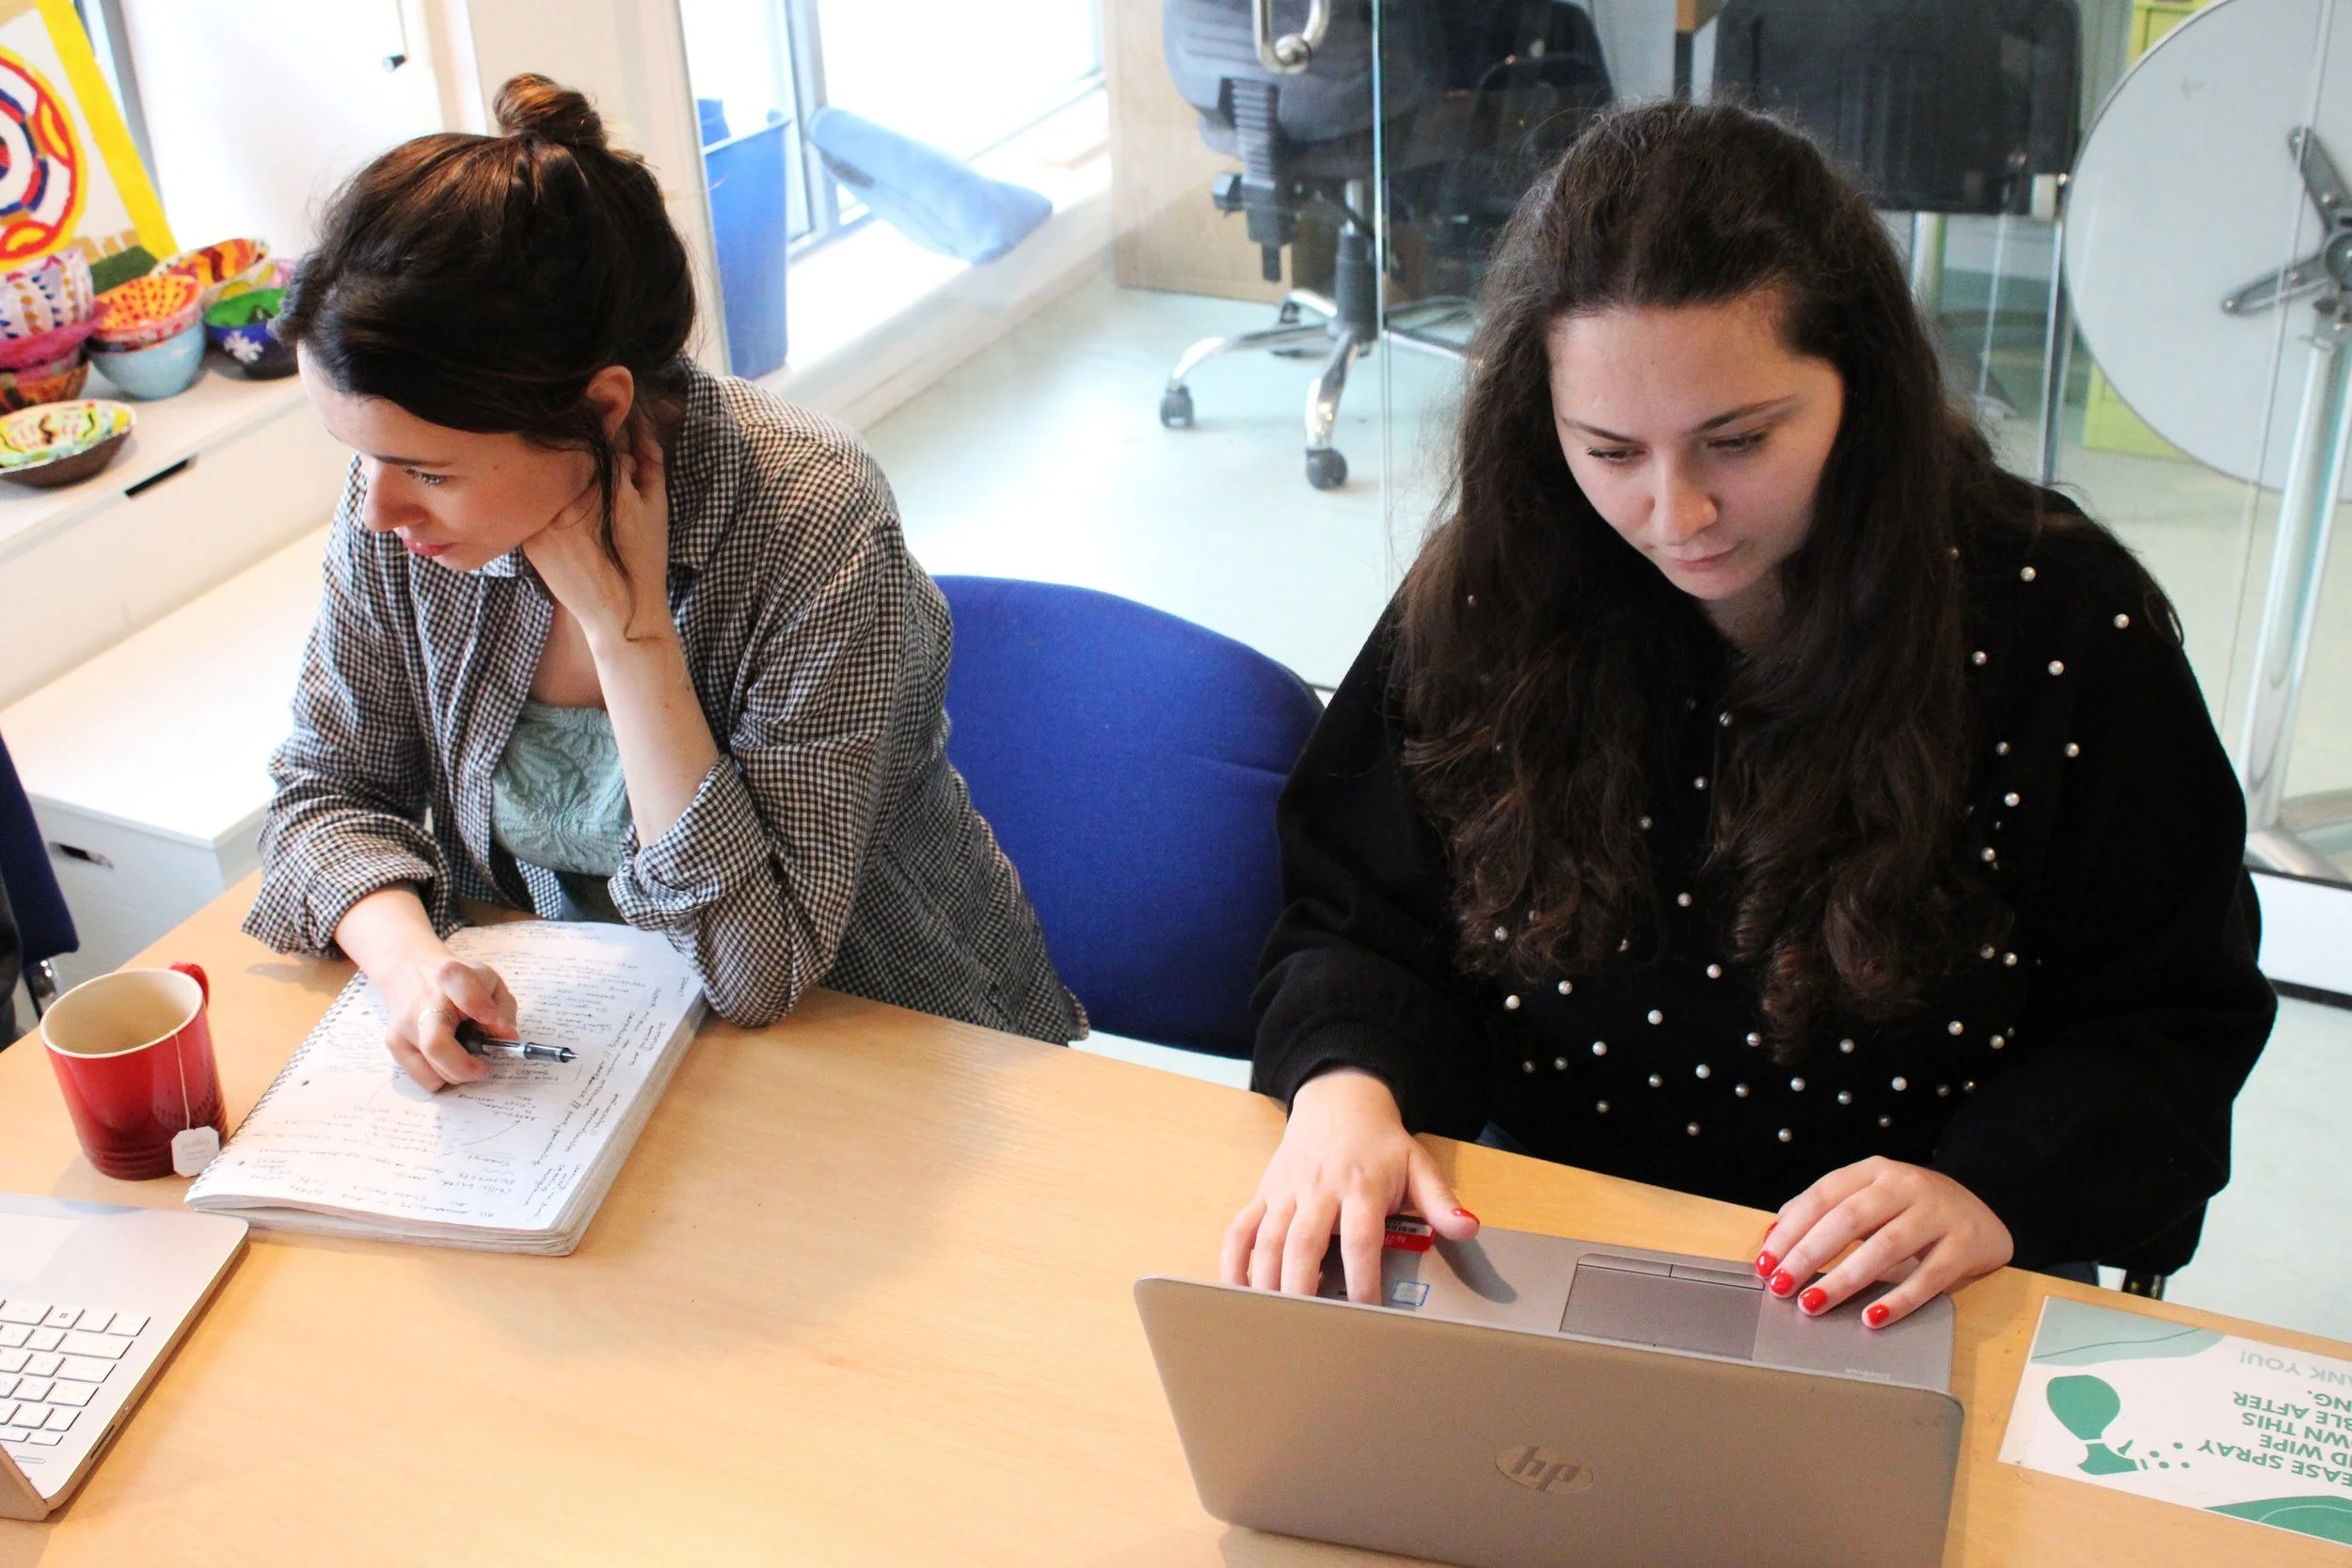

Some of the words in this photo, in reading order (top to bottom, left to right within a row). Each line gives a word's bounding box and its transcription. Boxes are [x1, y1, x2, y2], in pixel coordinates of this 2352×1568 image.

[2239, 1351, 2301, 1376] YOU!
[2233, 1390, 2311, 1420] AFTER
[2241, 1412, 2296, 1436] THIS
[2303, 1426, 2352, 1449] WN
[2197, 1439, 2285, 1470] SPRAY
[2258, 1433, 2323, 1461] WIPE
[1511, 1445, 1581, 1492] hp
